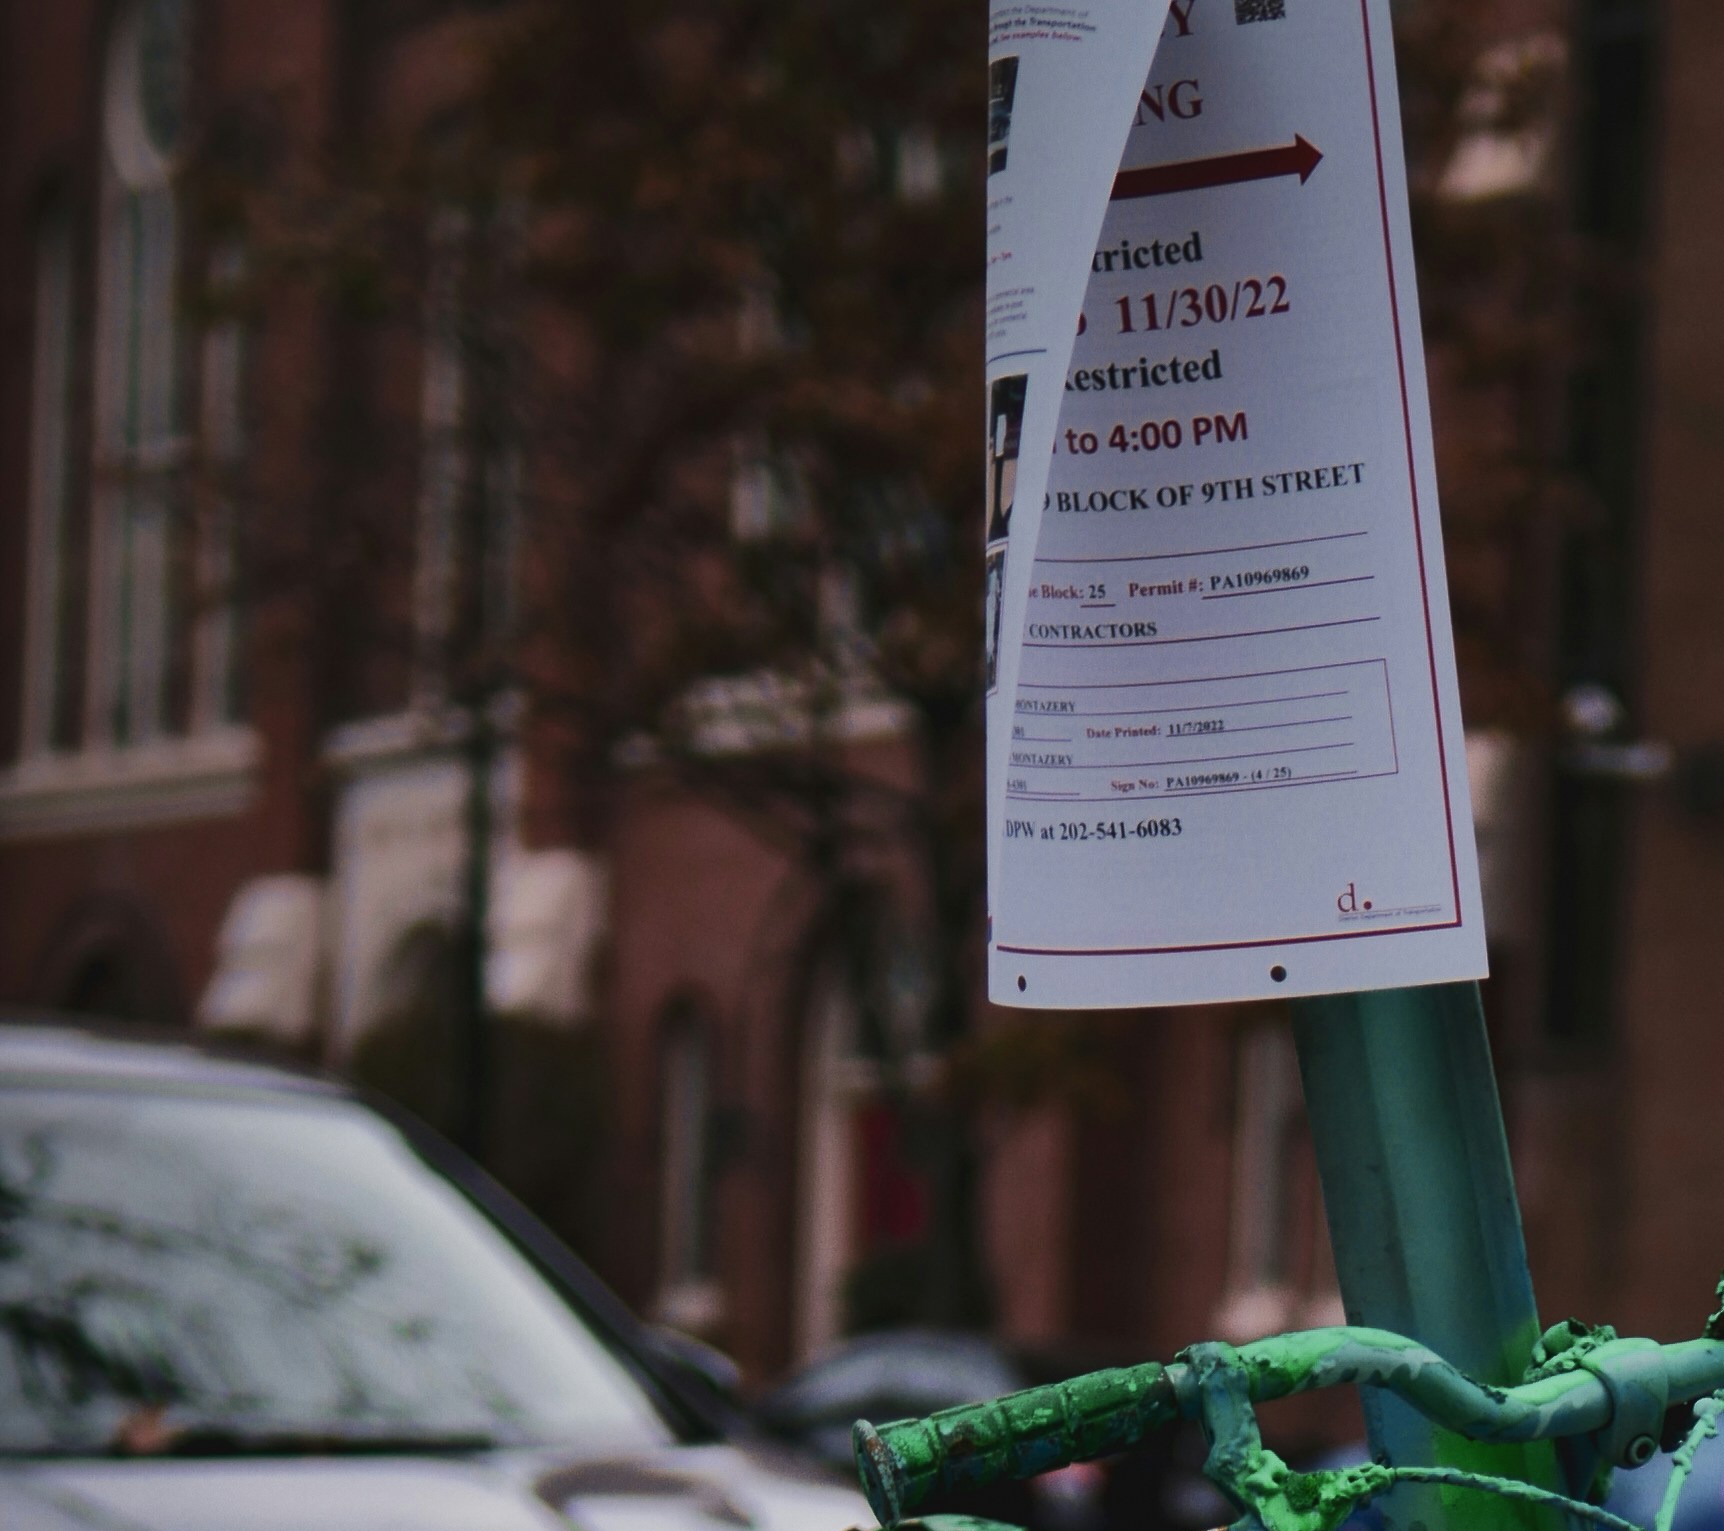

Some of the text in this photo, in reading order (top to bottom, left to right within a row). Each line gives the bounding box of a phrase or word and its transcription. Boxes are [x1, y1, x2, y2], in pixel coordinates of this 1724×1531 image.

[1115, 275, 1291, 334] 11/30/22
[1065, 412, 1249, 454] to 4:00 PM
[1056, 488, 1150, 513] BLOCK
[1156, 484, 1194, 508] OF
[1202, 477, 1255, 504] 9TH
[1262, 463, 1365, 497] STREET
[1041, 584, 1084, 599] Block:
[1088, 584, 1106, 599] 25
[1128, 579, 1184, 598] Permit
[1188, 577, 1204, 593] #:
[1210, 565, 1310, 591] PA10969869
[1029, 622, 1157, 640] CONTRACTORS
[1086, 719, 1225, 739] Date Printed: 11/7/2022
[1110, 780, 1136, 794] Sign
[1140, 779, 1159, 790] No:
[1041, 824, 1055, 840] at
[1060, 817, 1182, 841] 202-541-6083
